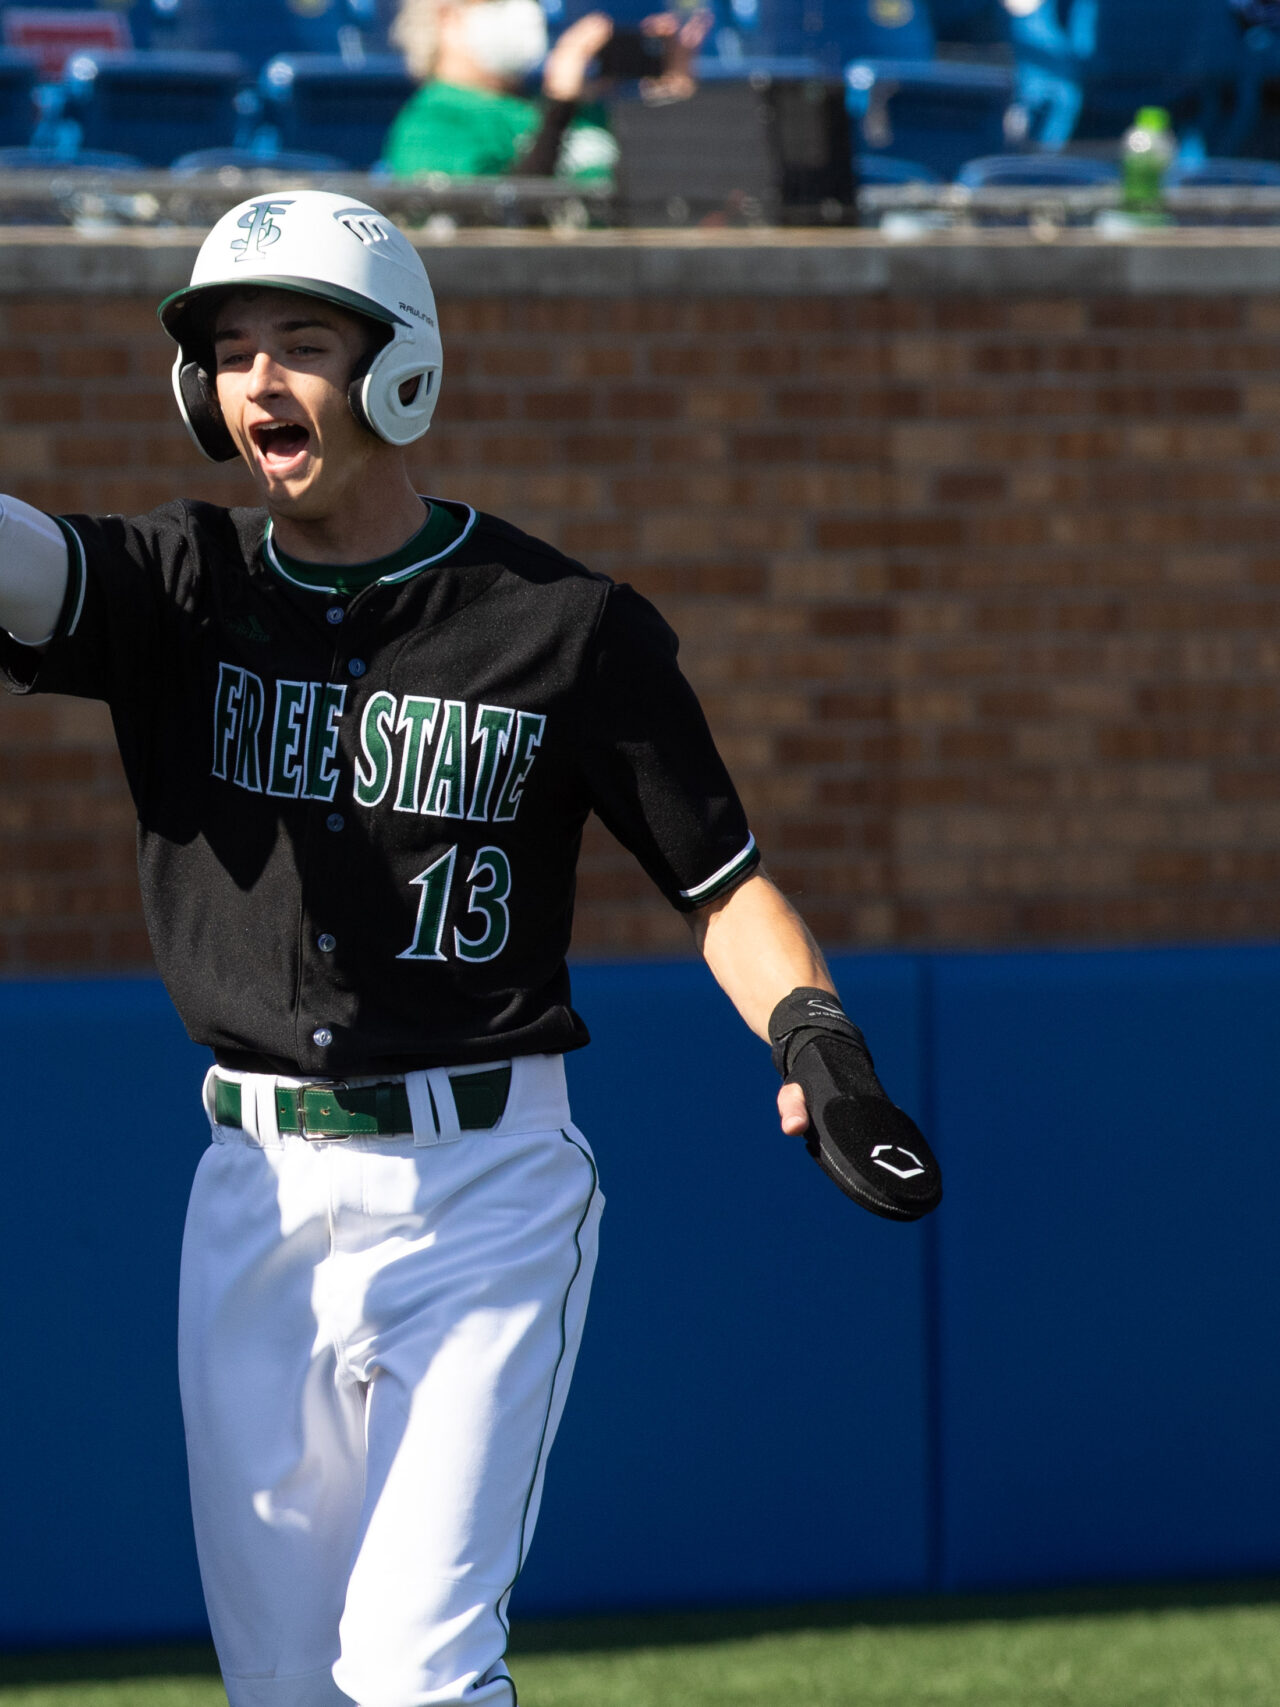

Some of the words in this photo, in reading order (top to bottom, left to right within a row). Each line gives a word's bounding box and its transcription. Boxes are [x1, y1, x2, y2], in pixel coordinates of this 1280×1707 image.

[212, 661, 348, 803] FREE
[352, 690, 548, 823] STATE
[395, 843, 512, 962] 13
